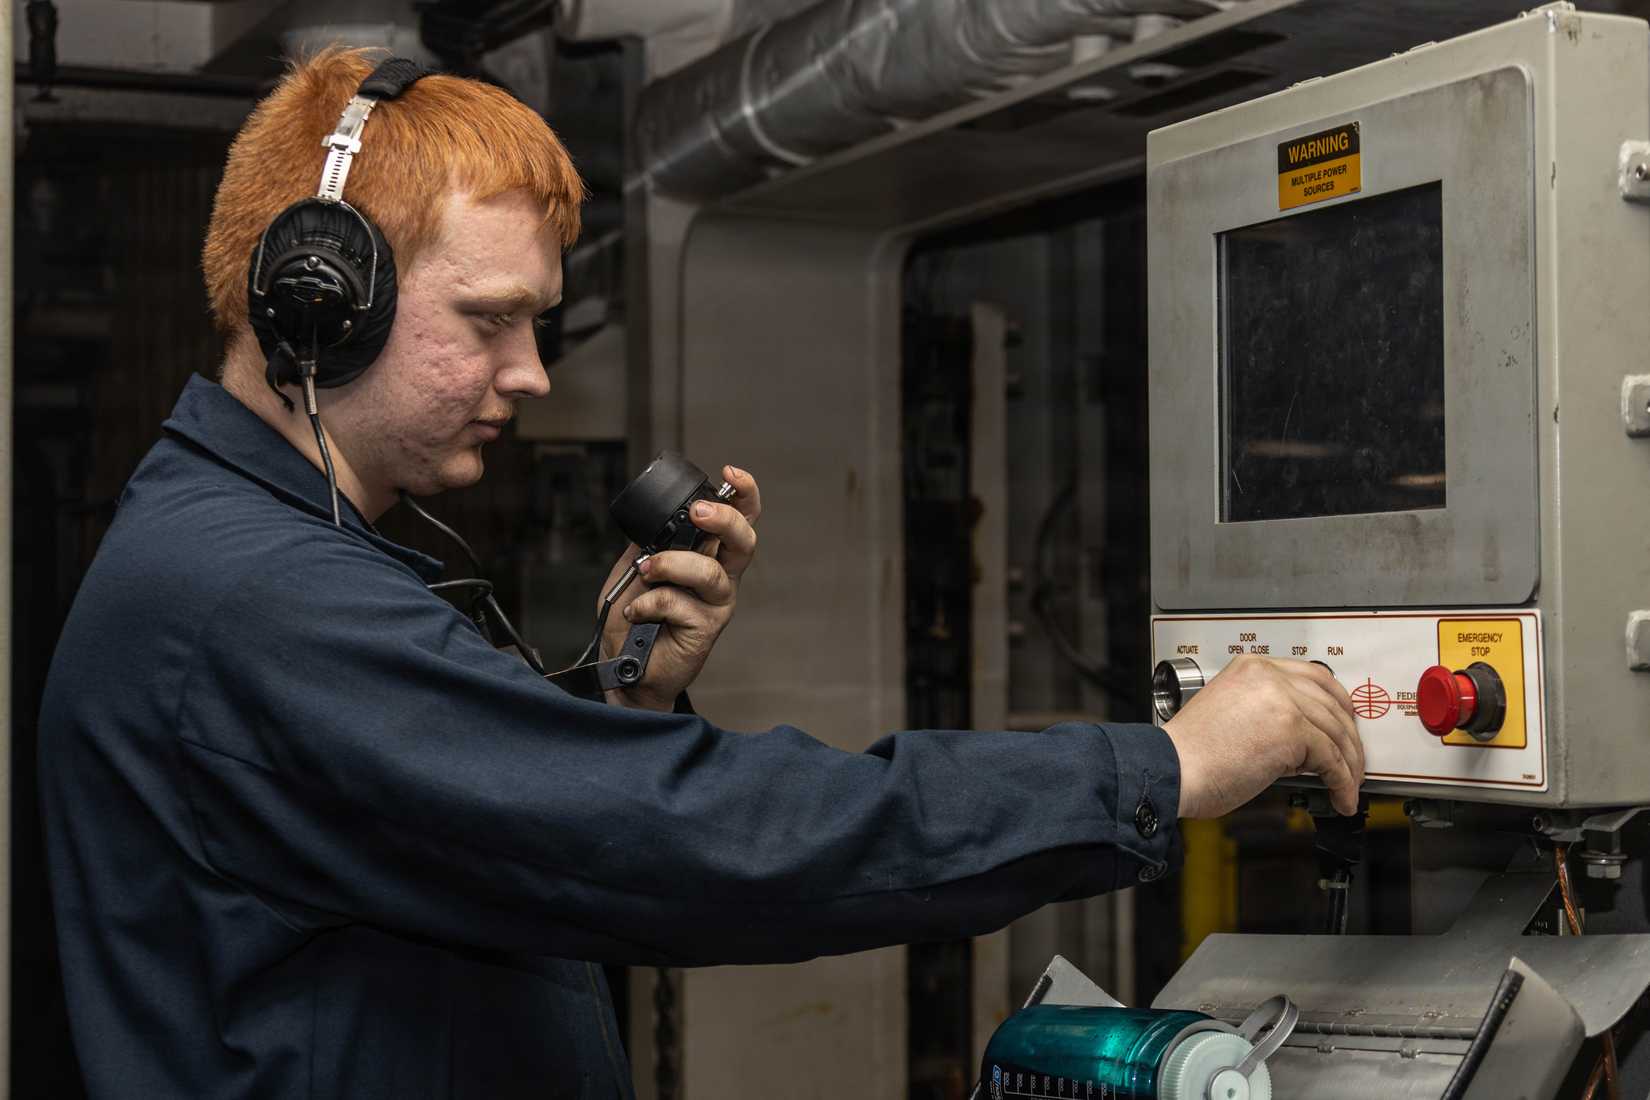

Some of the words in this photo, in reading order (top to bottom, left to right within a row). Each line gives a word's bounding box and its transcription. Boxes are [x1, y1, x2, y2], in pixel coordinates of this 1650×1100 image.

[1288, 132, 1349, 164] WARNING
[1291, 170, 1322, 187] MULTIPLE
[1323, 164, 1348, 178] POWER
[1303, 181, 1335, 197] SOURCES
[1240, 633, 1256, 642] DOOR
[1457, 632, 1503, 643] EMERGENCY
[1177, 645, 1199, 655] ACTUATE
[1228, 645, 1244, 655] OPEN
[1250, 645, 1270, 655] CLOSE
[1291, 646, 1308, 656] STOP
[1327, 646, 1344, 656] RUN
[1471, 646, 1491, 657] STOP
